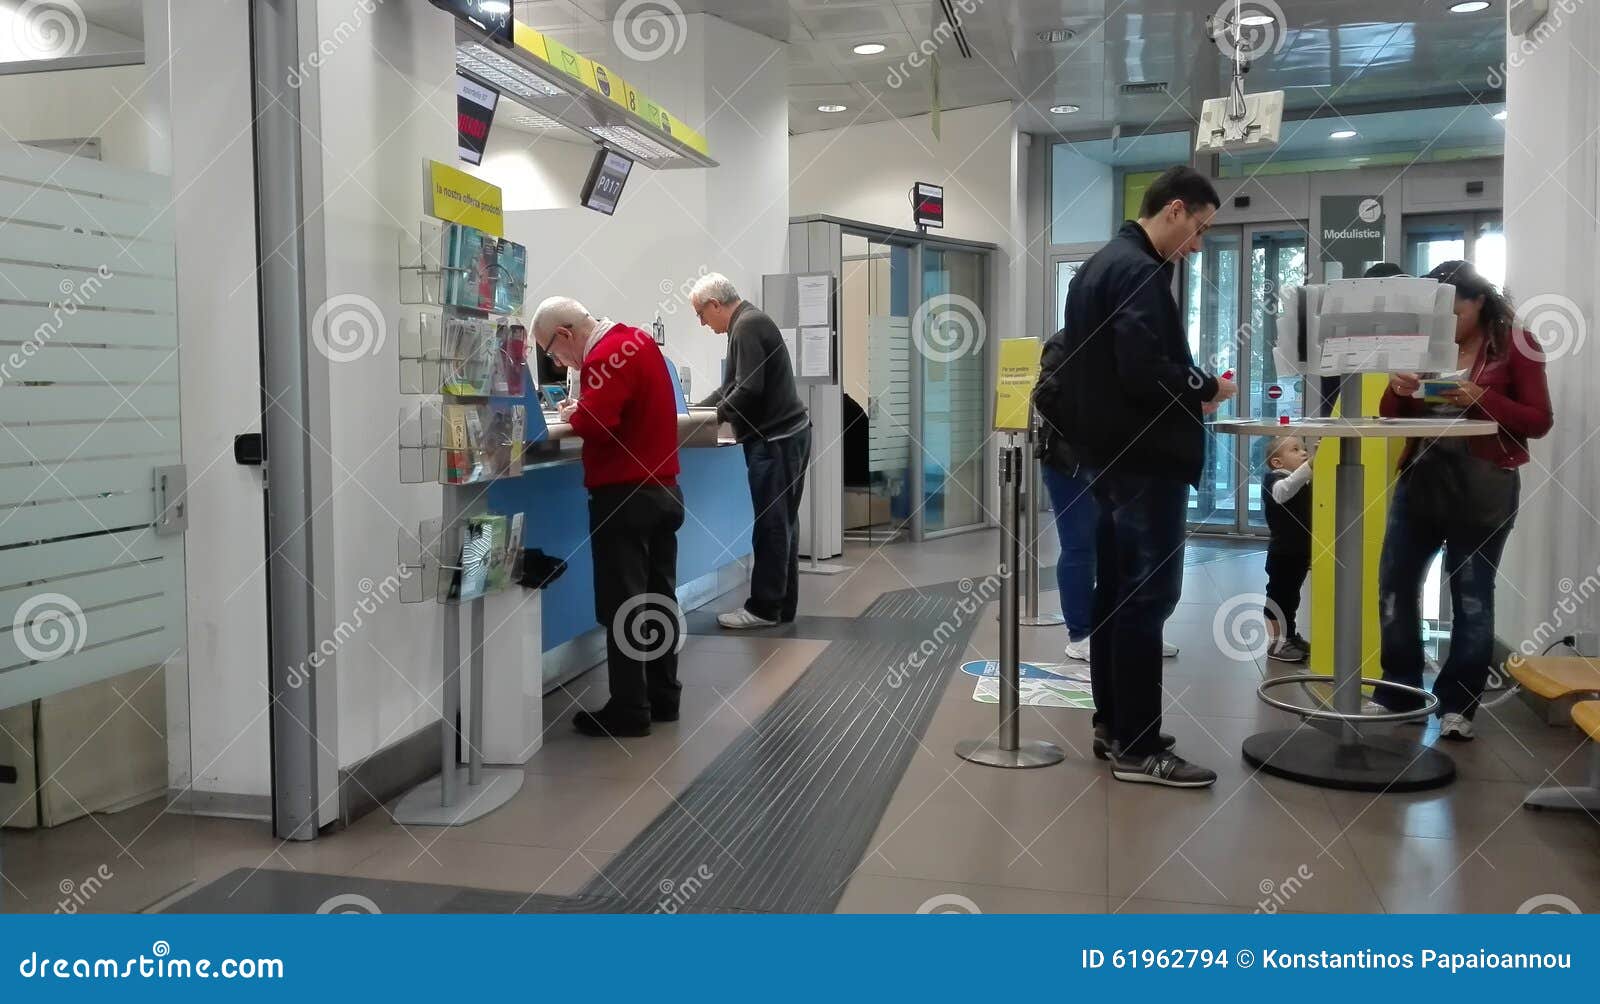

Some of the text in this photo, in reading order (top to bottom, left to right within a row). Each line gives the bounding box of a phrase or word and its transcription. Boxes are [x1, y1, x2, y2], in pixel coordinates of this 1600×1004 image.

[629, 91, 636, 111] 8
[598, 175, 620, 195] P017
[444, 188, 462, 202] nostra
[463, 192, 480, 208] offerta
[1324, 228, 1381, 239] Modulistica
